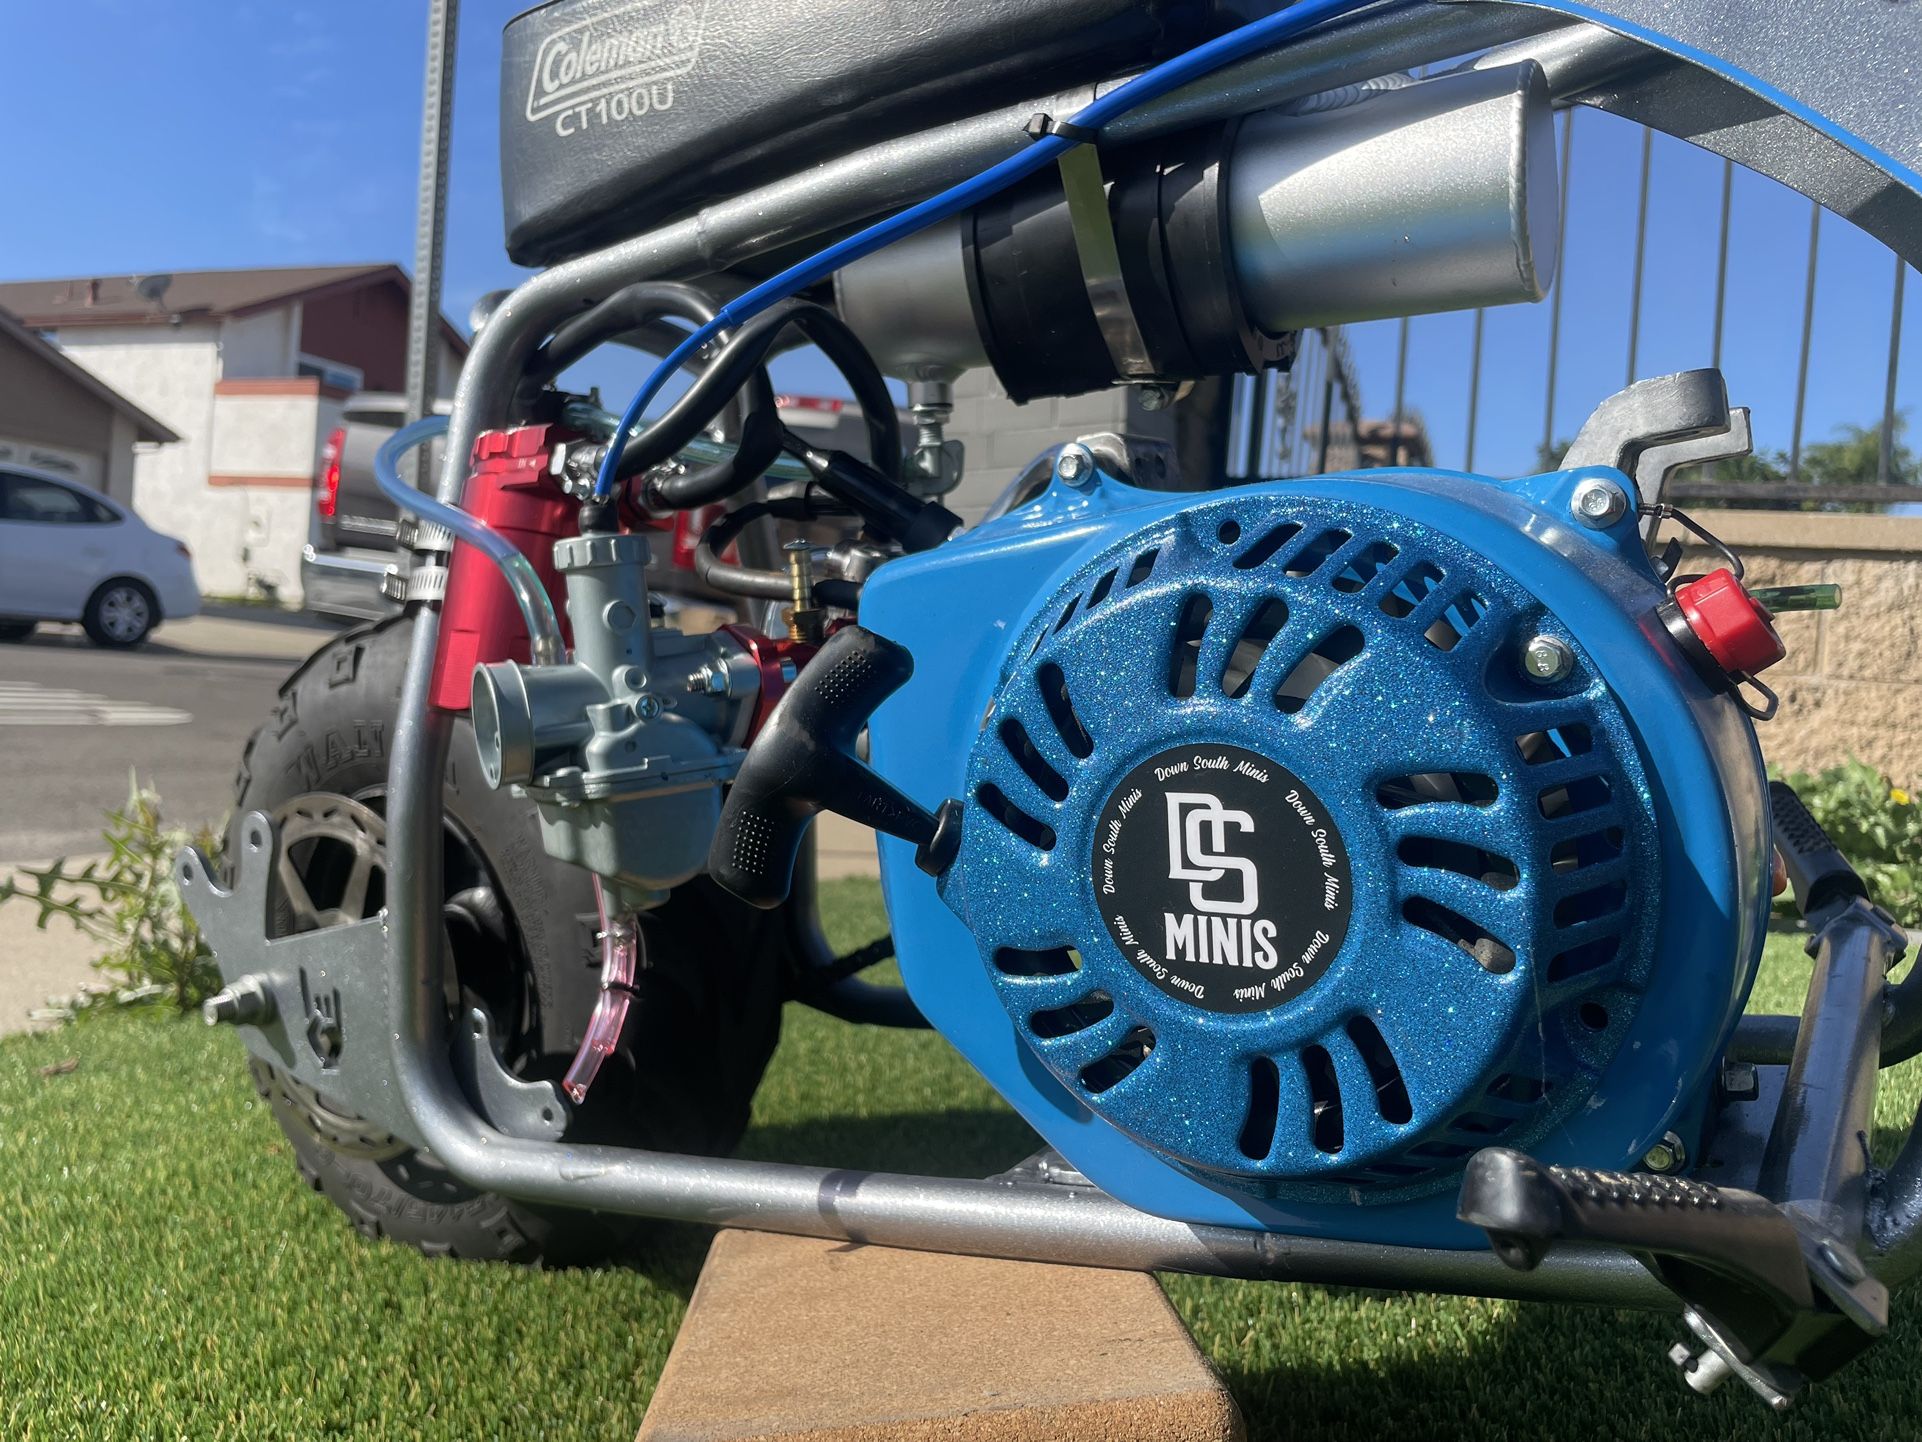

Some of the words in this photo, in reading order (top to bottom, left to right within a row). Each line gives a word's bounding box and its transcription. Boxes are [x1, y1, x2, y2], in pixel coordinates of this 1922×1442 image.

[555, 81, 674, 137] CT100U
[1154, 760, 1189, 782] Down
[1193, 755, 1230, 771] South
[1232, 760, 1270, 784] Minis
[1120, 788, 1143, 819] Minis
[1284, 789, 1314, 826] Down
[1102, 819, 1122, 855] South
[1311, 828, 1337, 868] South
[1102, 858, 1116, 895] Down
[1323, 871, 1340, 911] Minis
[1113, 914, 1139, 948] Minis
[1164, 912, 1279, 971] MINIS
[1302, 929, 1330, 965] Down
[1137, 947, 1169, 981] South
[1270, 963, 1305, 991] South
[1169, 973, 1205, 1000] Down
[1232, 982, 1267, 1003] Minis
